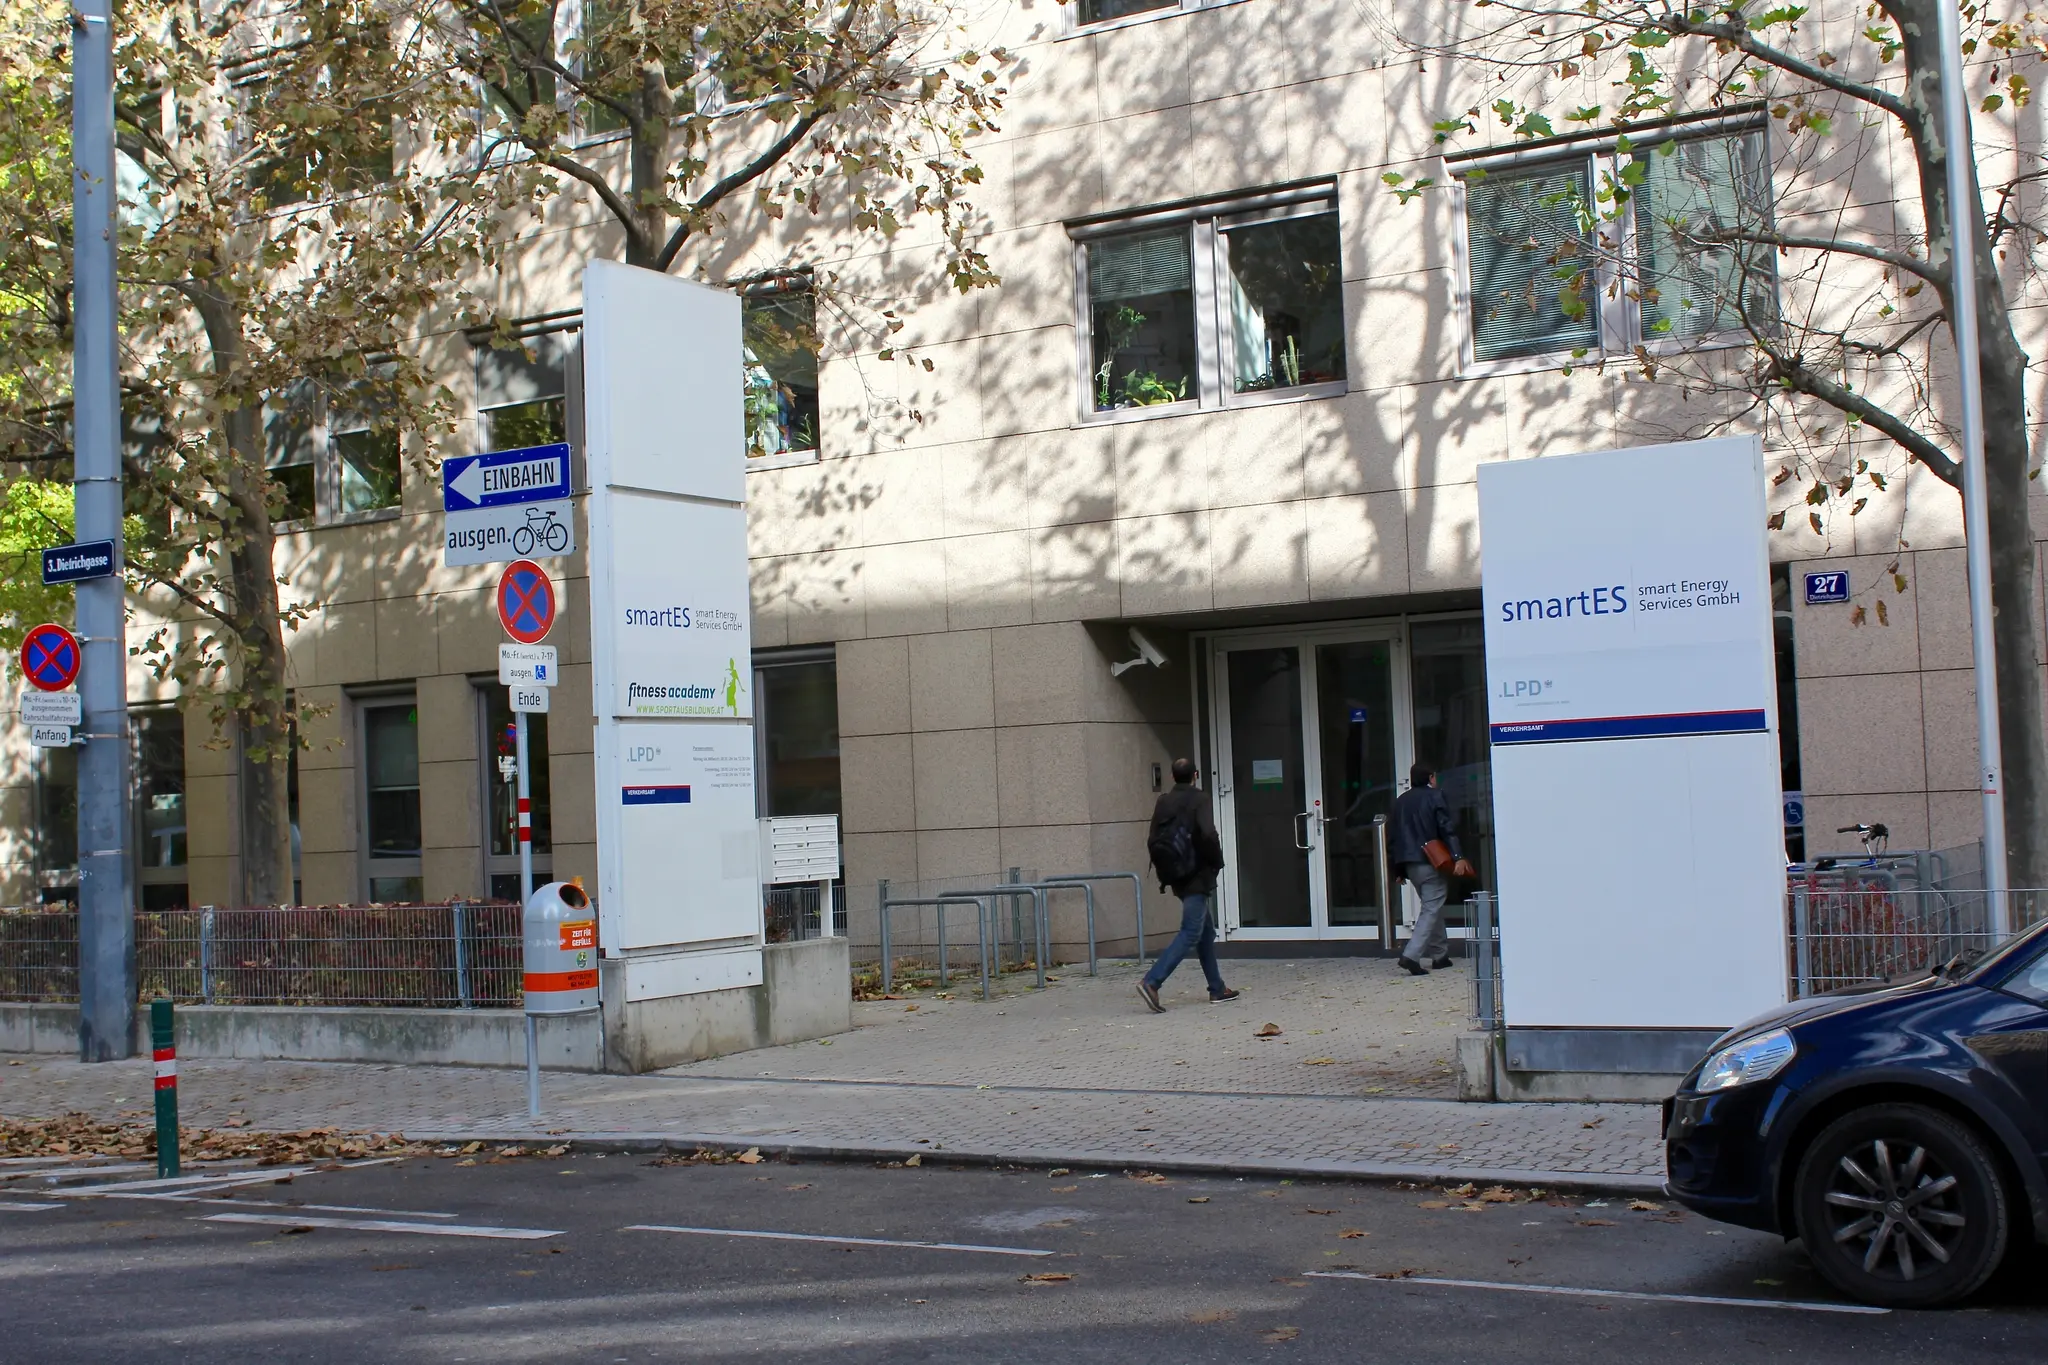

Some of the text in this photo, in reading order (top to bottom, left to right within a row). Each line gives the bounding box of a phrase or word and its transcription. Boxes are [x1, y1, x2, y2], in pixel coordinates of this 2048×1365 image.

[483, 461, 555, 492] EINBAHN
[448, 526, 511, 551] ausgen.
[57, 554, 108, 571] Dietrichgasse
[1638, 579, 1729, 596] smart Energy
[1814, 575, 1838, 593] 27
[1501, 585, 1628, 622] smartES
[1639, 592, 1740, 612] Services GmbH
[626, 607, 691, 628] smartES
[695, 609, 738, 621] smart Energy
[695, 620, 743, 631] Services GmbH
[510, 669, 533, 679] ausgen.
[518, 692, 541, 706] Ende
[628, 682, 716, 707] fitness academy
[636, 705, 725, 715] WWW.SPORTAUSBILDUNG.AT
[35, 729, 67, 743] Anfang
[1500, 725, 1544, 733] VERKEHRSAMT
